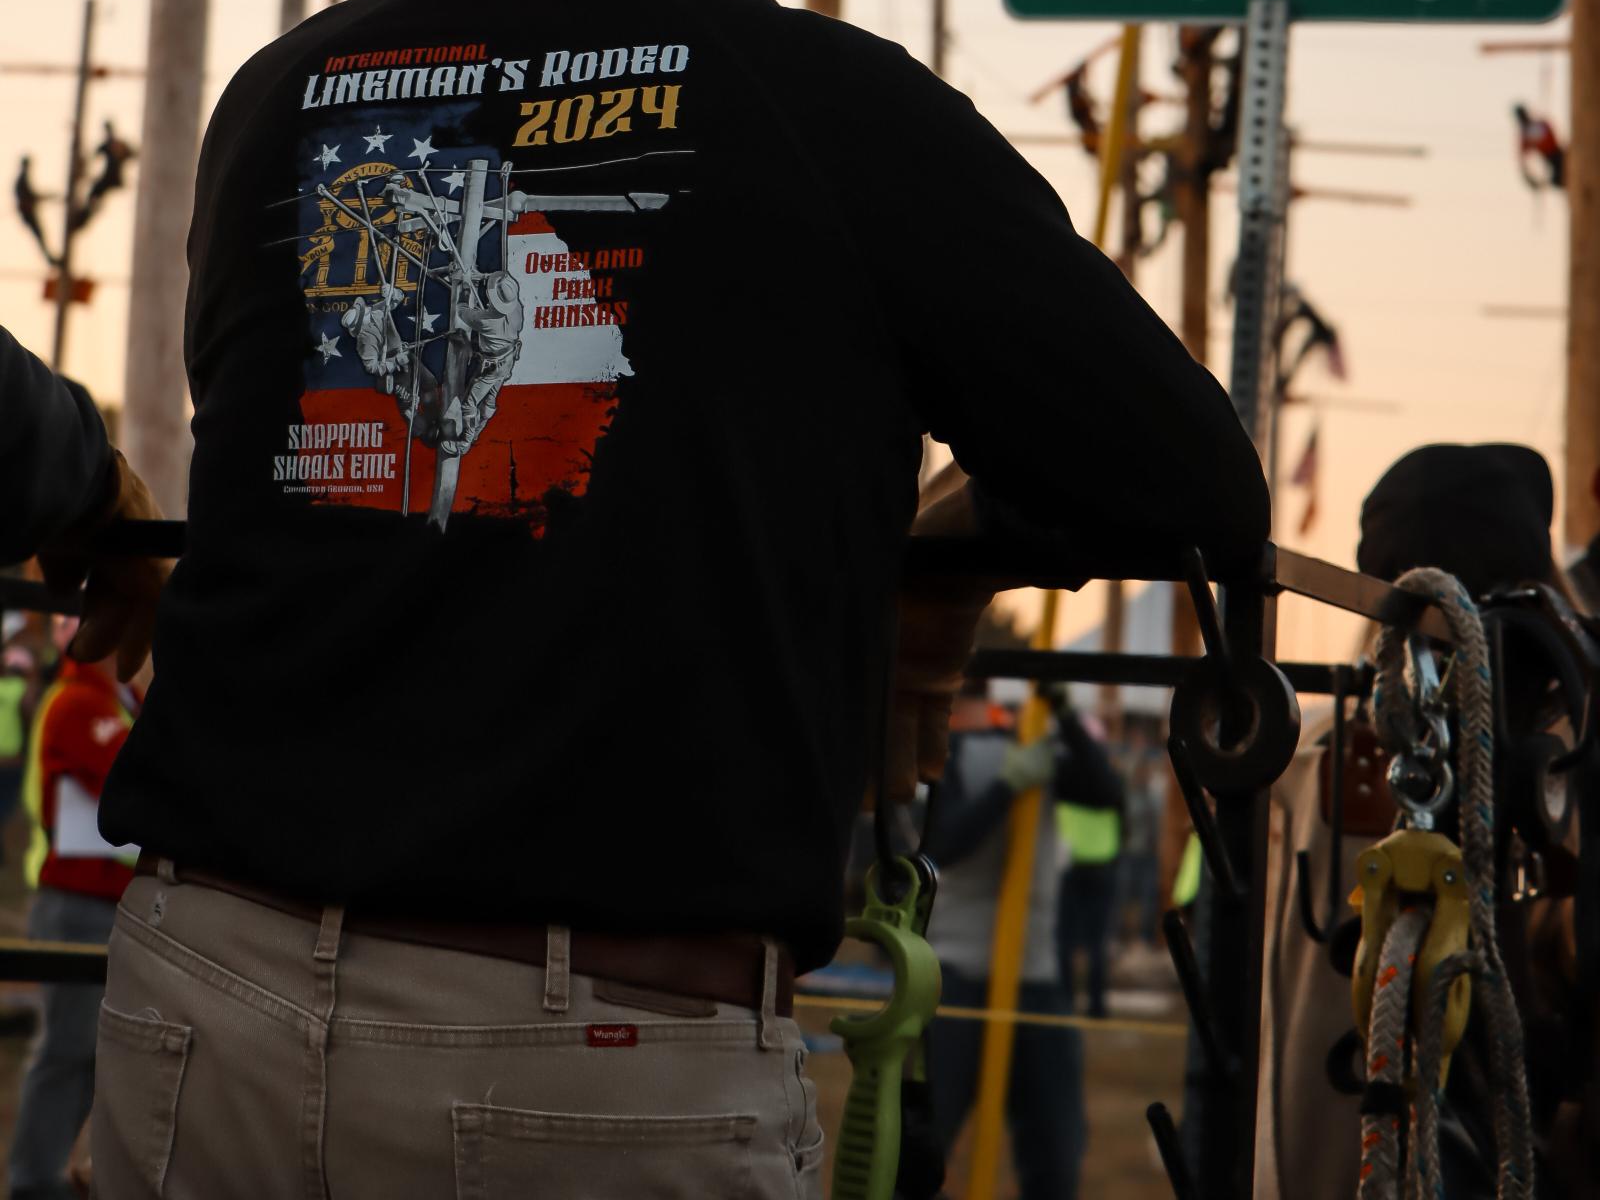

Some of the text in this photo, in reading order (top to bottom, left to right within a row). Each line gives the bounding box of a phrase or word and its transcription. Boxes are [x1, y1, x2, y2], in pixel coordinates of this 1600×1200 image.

[325, 42, 489, 73] INTERNATIONAL
[301, 43, 690, 110] LINEMAN'S RODEO
[511, 84, 684, 148] 2024
[525, 247, 644, 275] OVERLAND
[552, 276, 614, 301] PARK
[534, 301, 629, 329] KANSAS
[288, 422, 384, 449] SNAPPING
[273, 453, 396, 481] SHOALS EMC
[593, 1028, 631, 1043] Wrangler
